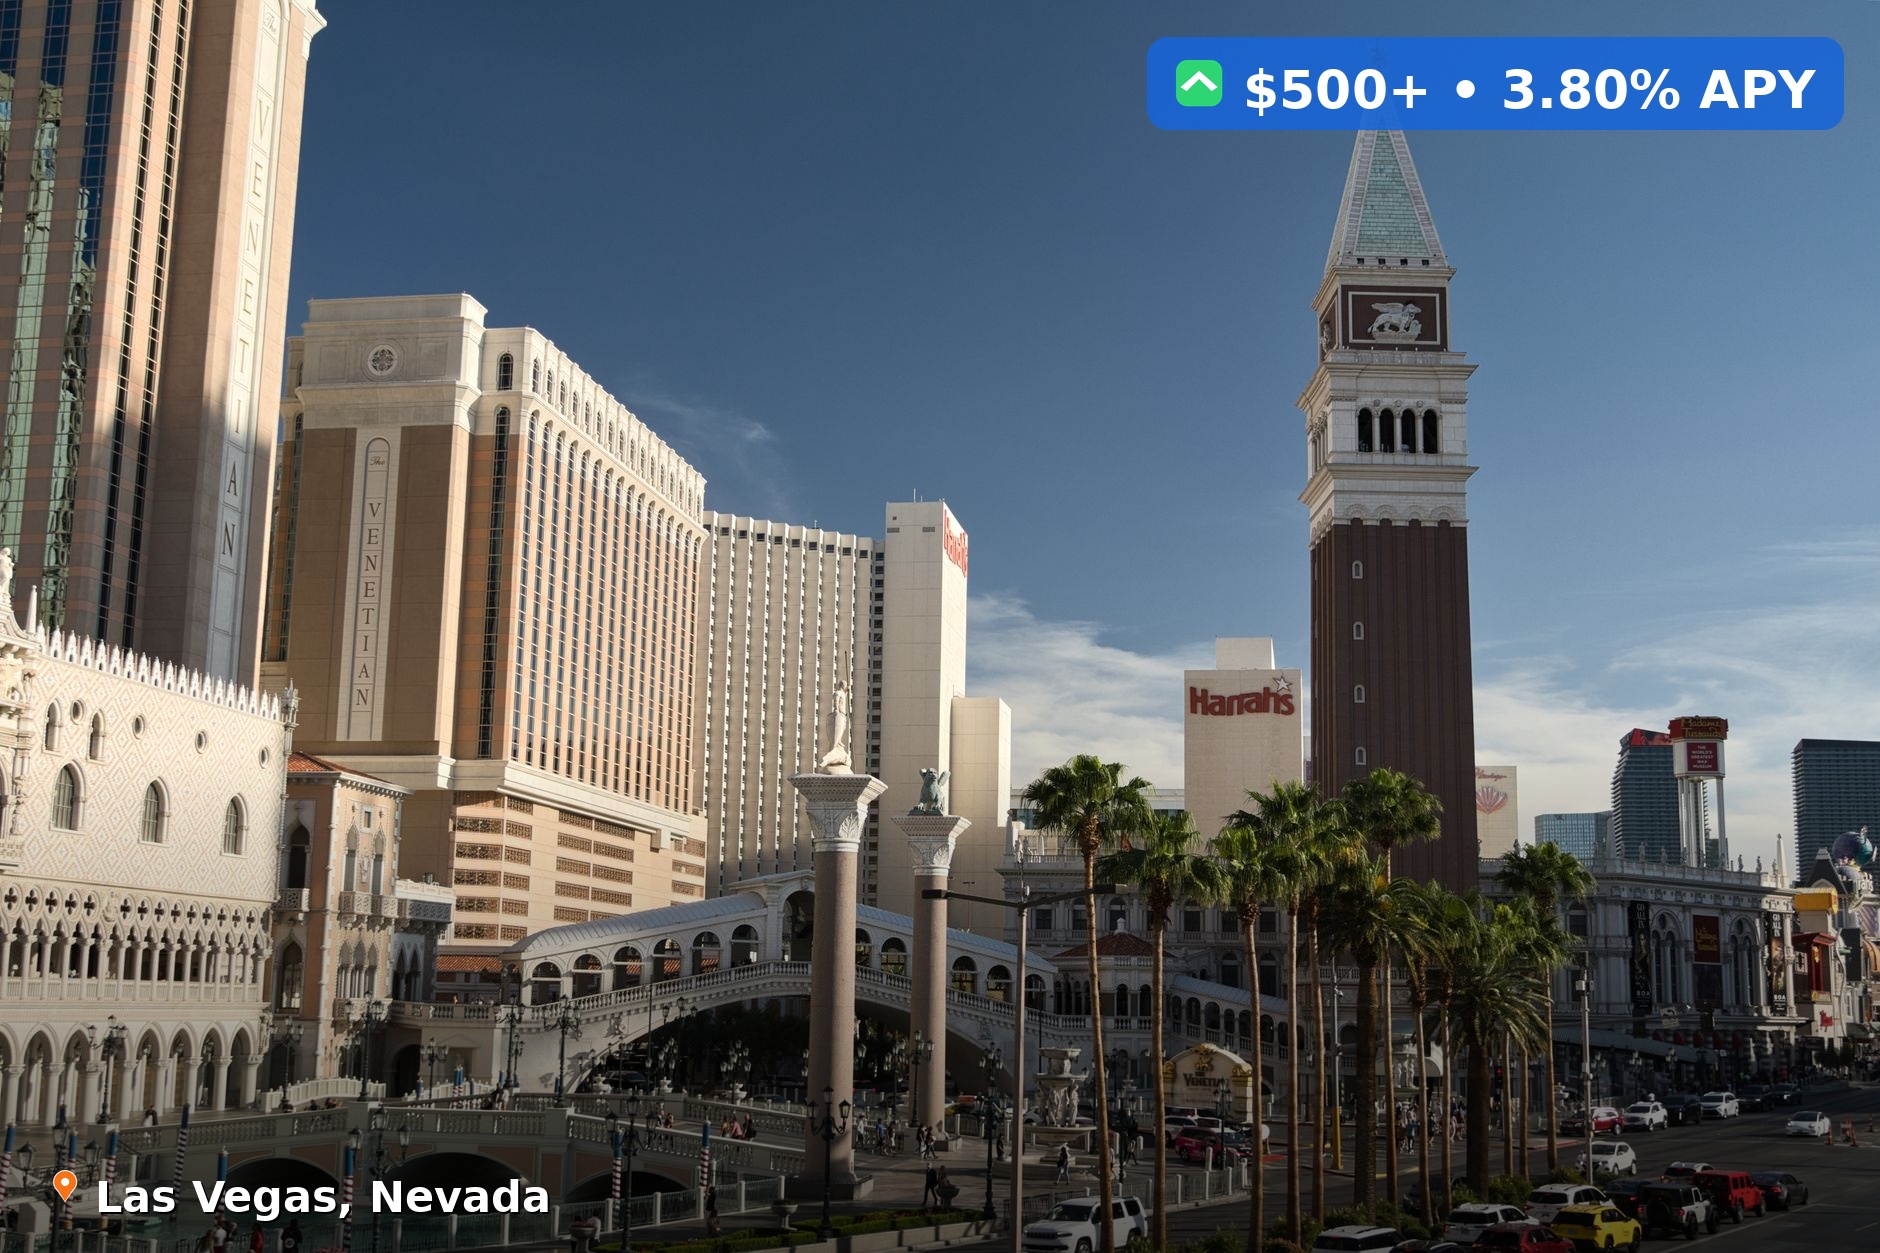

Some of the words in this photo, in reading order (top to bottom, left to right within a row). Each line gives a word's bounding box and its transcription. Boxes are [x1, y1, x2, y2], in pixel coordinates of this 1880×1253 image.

[221, 97, 272, 559] VENETIAN
[369, 455, 386, 466] The
[355, 501, 382, 706] VENETIAN
[1772, 913, 1781, 921] GO
[1772, 921, 1782, 930] ALL
